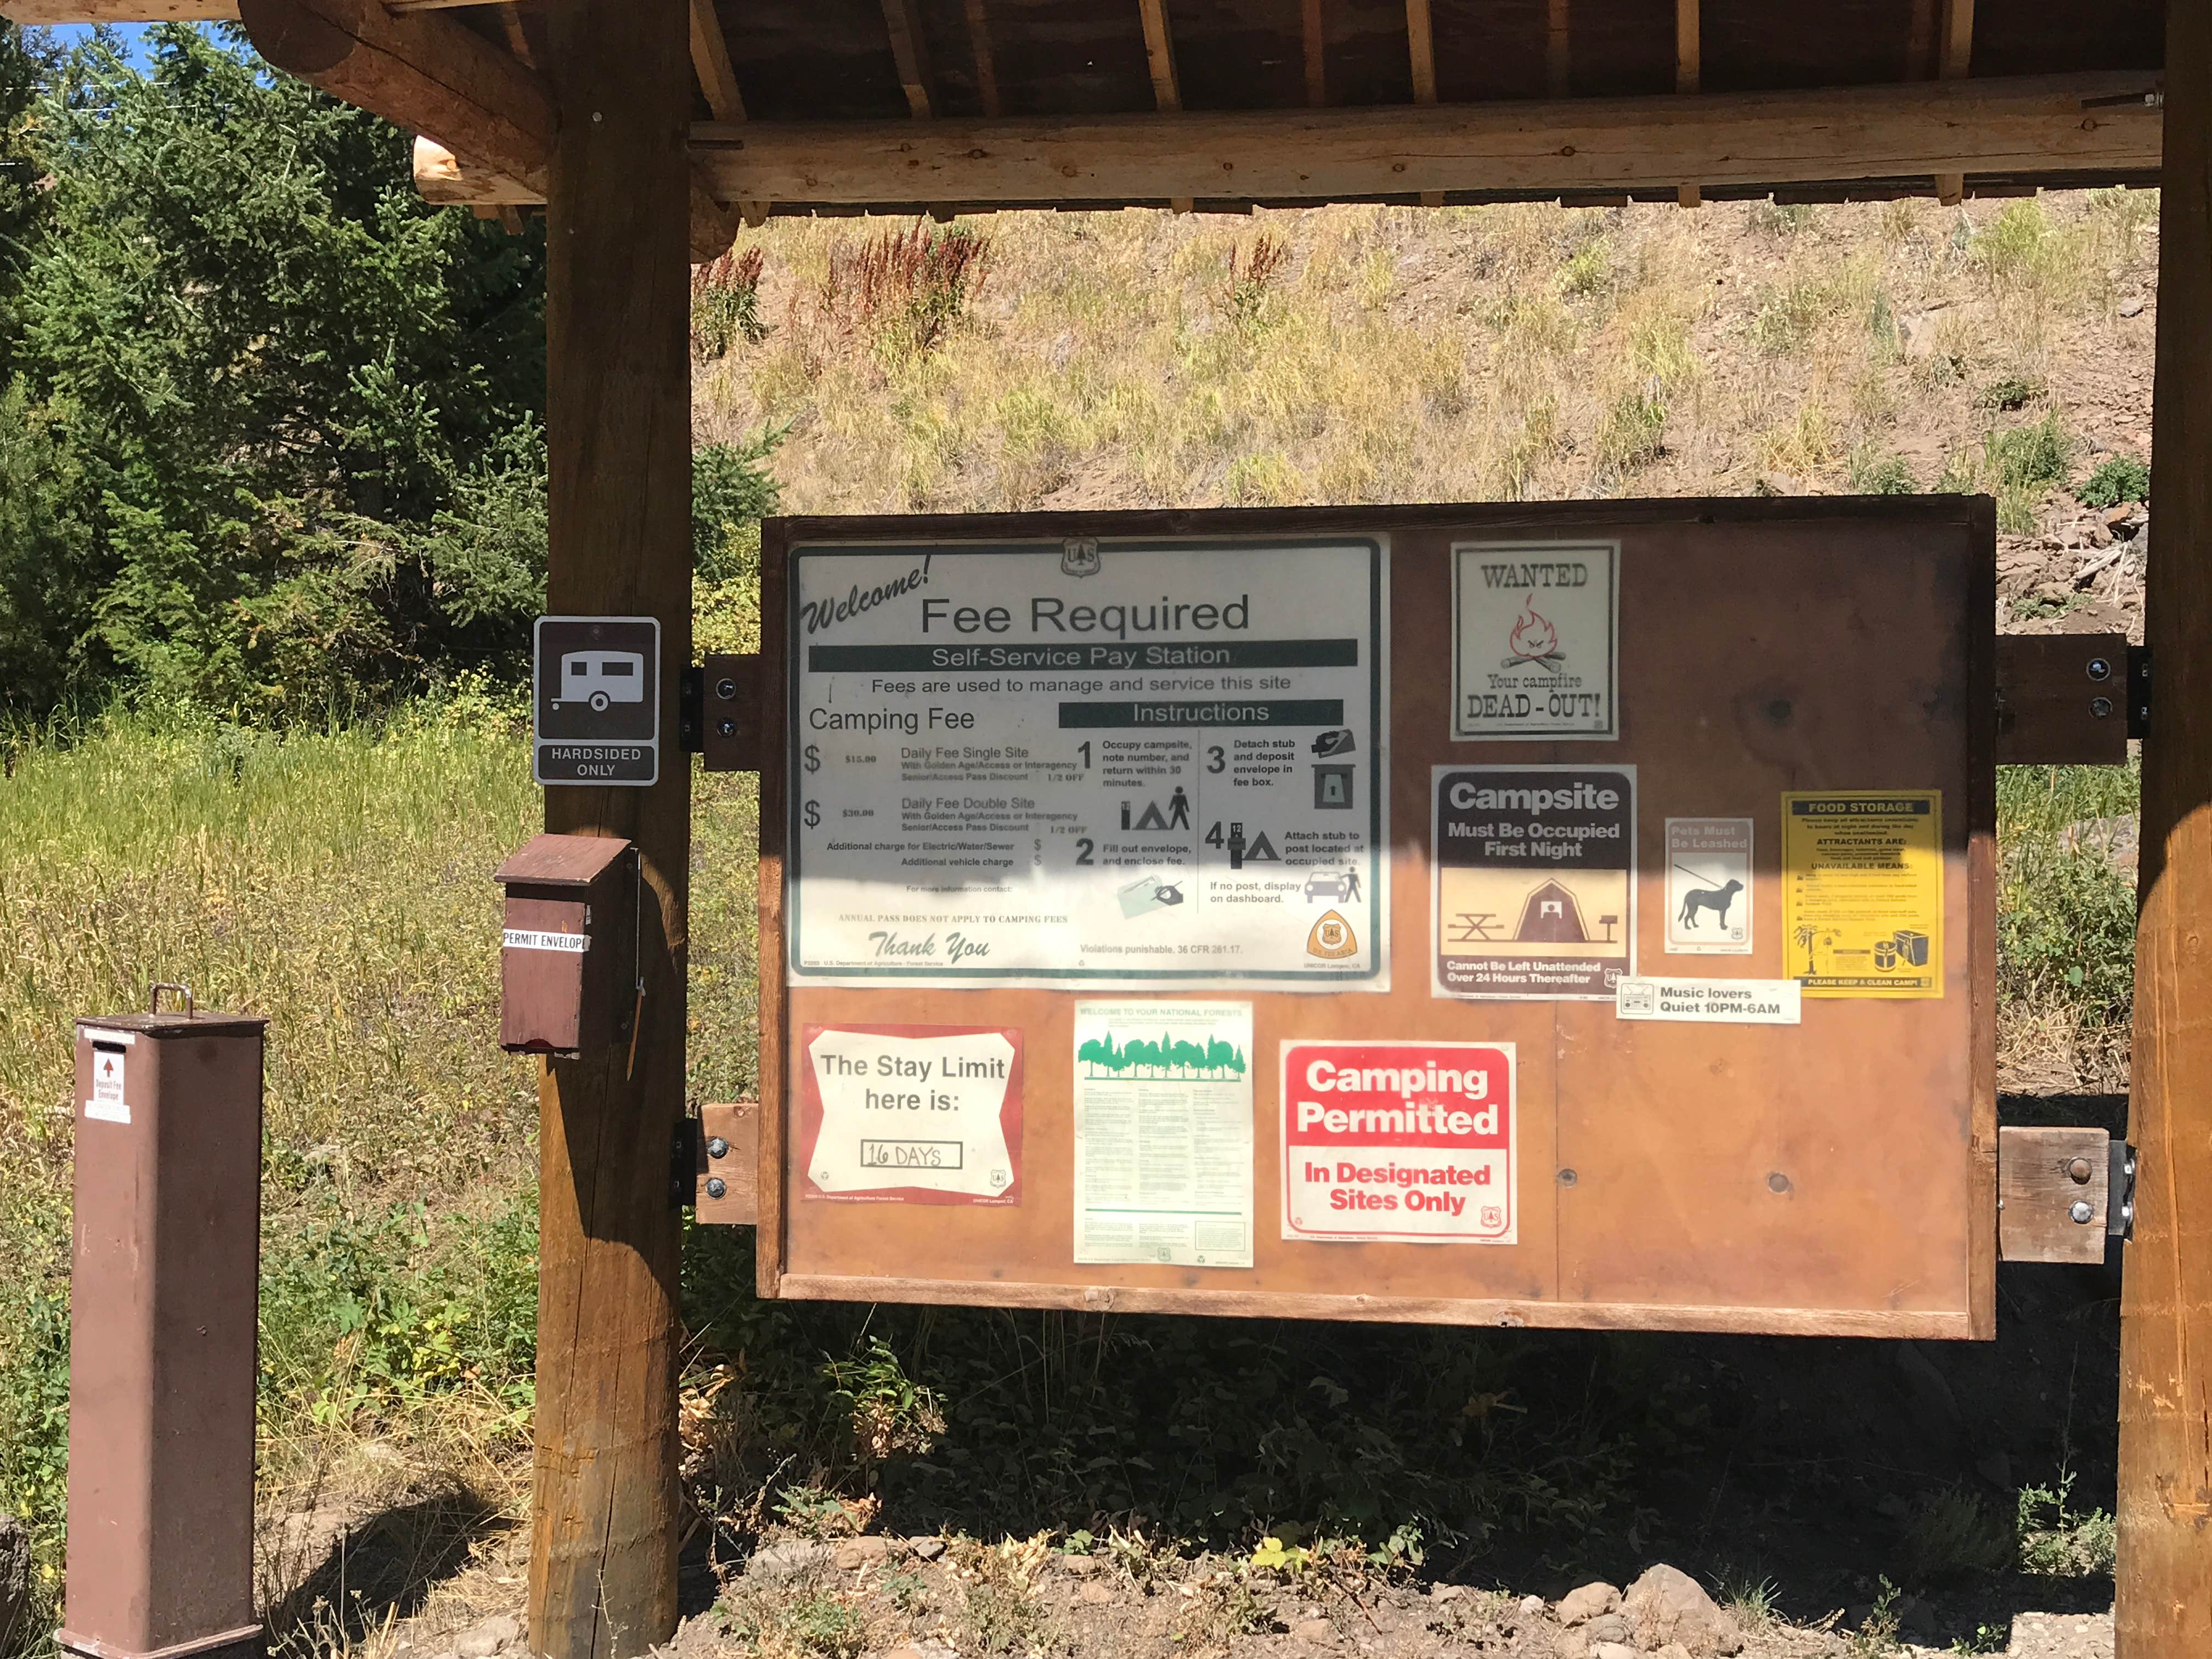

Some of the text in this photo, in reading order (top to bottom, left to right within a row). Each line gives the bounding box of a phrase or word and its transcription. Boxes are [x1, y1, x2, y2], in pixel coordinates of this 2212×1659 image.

[1481, 563, 1588, 588] WANTED
[800, 555, 932, 634] Welcome!
[922, 594, 1248, 640] Fee Required
[933, 646, 1230, 669] Self-Service Pay Station
[872, 675, 1290, 695] Fees are used to manage and service this site
[1487, 673, 1582, 692] Your campfire
[1133, 703, 1269, 722] Instructions
[1467, 694, 1530, 718] DEAD
[809, 707, 975, 735] Camping Fee
[1103, 740, 1192, 752] Occupy campsite,
[1234, 739, 1295, 749] Detach stub
[552, 748, 641, 760] HARDSIDED
[804, 744, 821, 775] $
[901, 747, 1029, 760] Daily Fee Single Site
[1078, 741, 1091, 769] 1
[1103, 752, 1189, 763] note number, and
[1206, 746, 1226, 774] 3
[1234, 752, 1295, 763] and deposit
[577, 764, 615, 776] ONLY
[1103, 766, 1181, 775] return within 30
[1234, 765, 1293, 776] envelope in
[1103, 778, 1145, 787] minutes.
[1233, 777, 1274, 787] fee box.
[901, 797, 1035, 811] Daily Fee Double Site
[1449, 782, 1619, 815] Campsite
[1809, 802, 1914, 812] FOOD STORAGE
[804, 799, 821, 830] $
[1205, 821, 1224, 849] 4
[1285, 832, 1318, 840] Attach
[1322, 832, 1346, 840] stub
[1448, 823, 1620, 840] Must Be Occupied
[1672, 826, 1735, 836] Pets Must
[1103, 844, 1191, 855] Fill out envelope,
[1285, 844, 1364, 855] post located at
[1672, 838, 1747, 849] Be Leashed
[1076, 838, 1094, 866] 2
[1485, 842, 1582, 860] First Night
[1103, 857, 1185, 866] and enclose fee.
[1285, 856, 1360, 867] occupied site.
[1210, 881, 1217, 891] If
[1235, 882, 1262, 893] post,
[1264, 882, 1301, 893] display
[1226, 894, 1284, 904] dashboard.
[839, 914, 875, 922] ANNUAL
[878, 915, 900, 923] PASS
[902, 915, 927, 923] DOES
[951, 915, 980, 923] APPLY
[983, 915, 996, 923] TO
[998, 915, 1041, 923] CAMPING
[1044, 916, 1068, 924] FEES
[503, 933, 538, 945] PERMIT
[868, 931, 990, 964] Thank You
[1080, 944, 1122, 953] Violations
[1125, 945, 1175, 956] punishable.
[1177, 945, 1188, 953] 36
[1190, 945, 1209, 954] CFR
[1447, 961, 1601, 972] Cannot Be Left Unattended
[1447, 973, 1590, 984] Over 24 Hours Thereafter
[1661, 987, 1752, 998] Music lovers
[1660, 1001, 1780, 1014] Quiet 10PM-6AM
[820, 1054, 1005, 1082] The Stay Limit
[1306, 1060, 1487, 1099] Camping
[865, 1088, 959, 1111] here is:
[1297, 1102, 1498, 1135] Permitted
[895, 1146, 941, 1166] DAYS
[1305, 1162, 1490, 1188] In Designated
[1330, 1189, 1466, 1216] Sites Only
